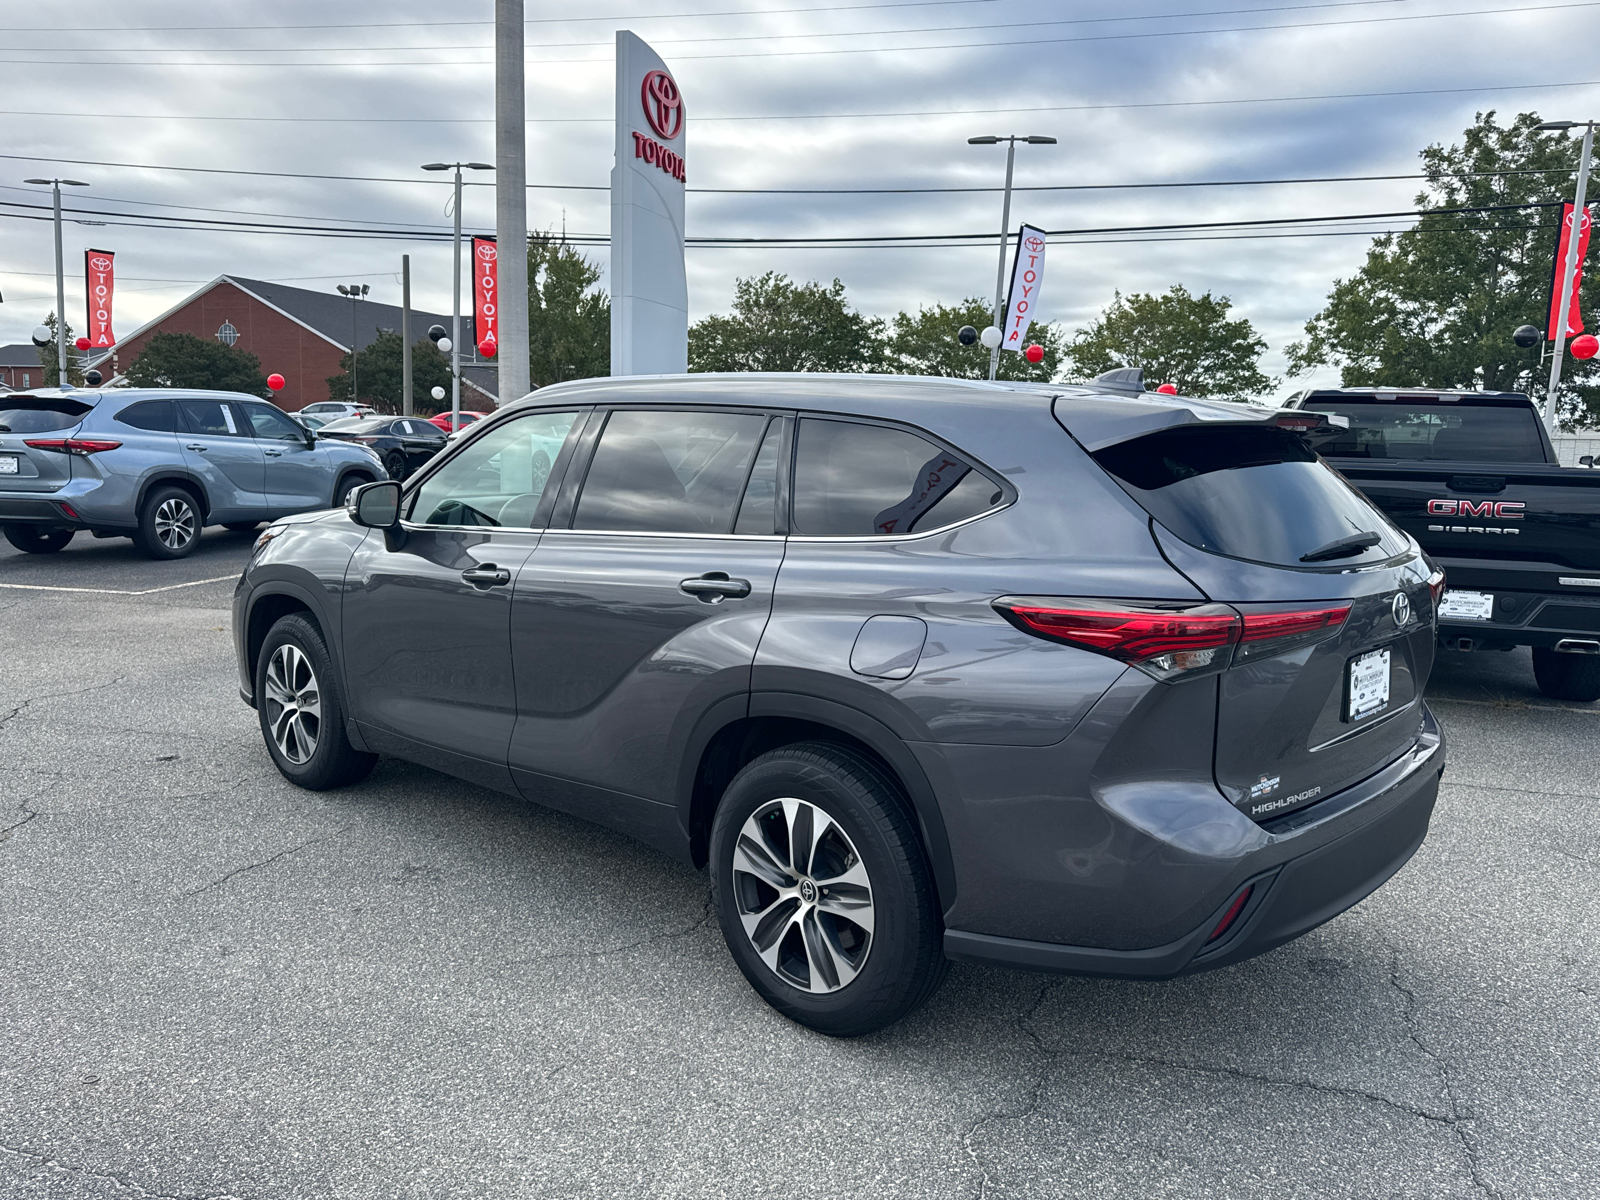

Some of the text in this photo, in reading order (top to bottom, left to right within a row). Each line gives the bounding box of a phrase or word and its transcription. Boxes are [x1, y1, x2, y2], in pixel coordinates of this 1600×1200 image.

[632, 131, 687, 184] TOYOTA
[95, 273, 108, 345] TOYOTA
[482, 263, 496, 342] TOYOTA
[1008, 255, 1039, 342] TOYOTA
[1427, 499, 1526, 519] GMC
[1427, 525, 1520, 535] SIERRA
[1252, 786, 1321, 814] HIGHLANDER
